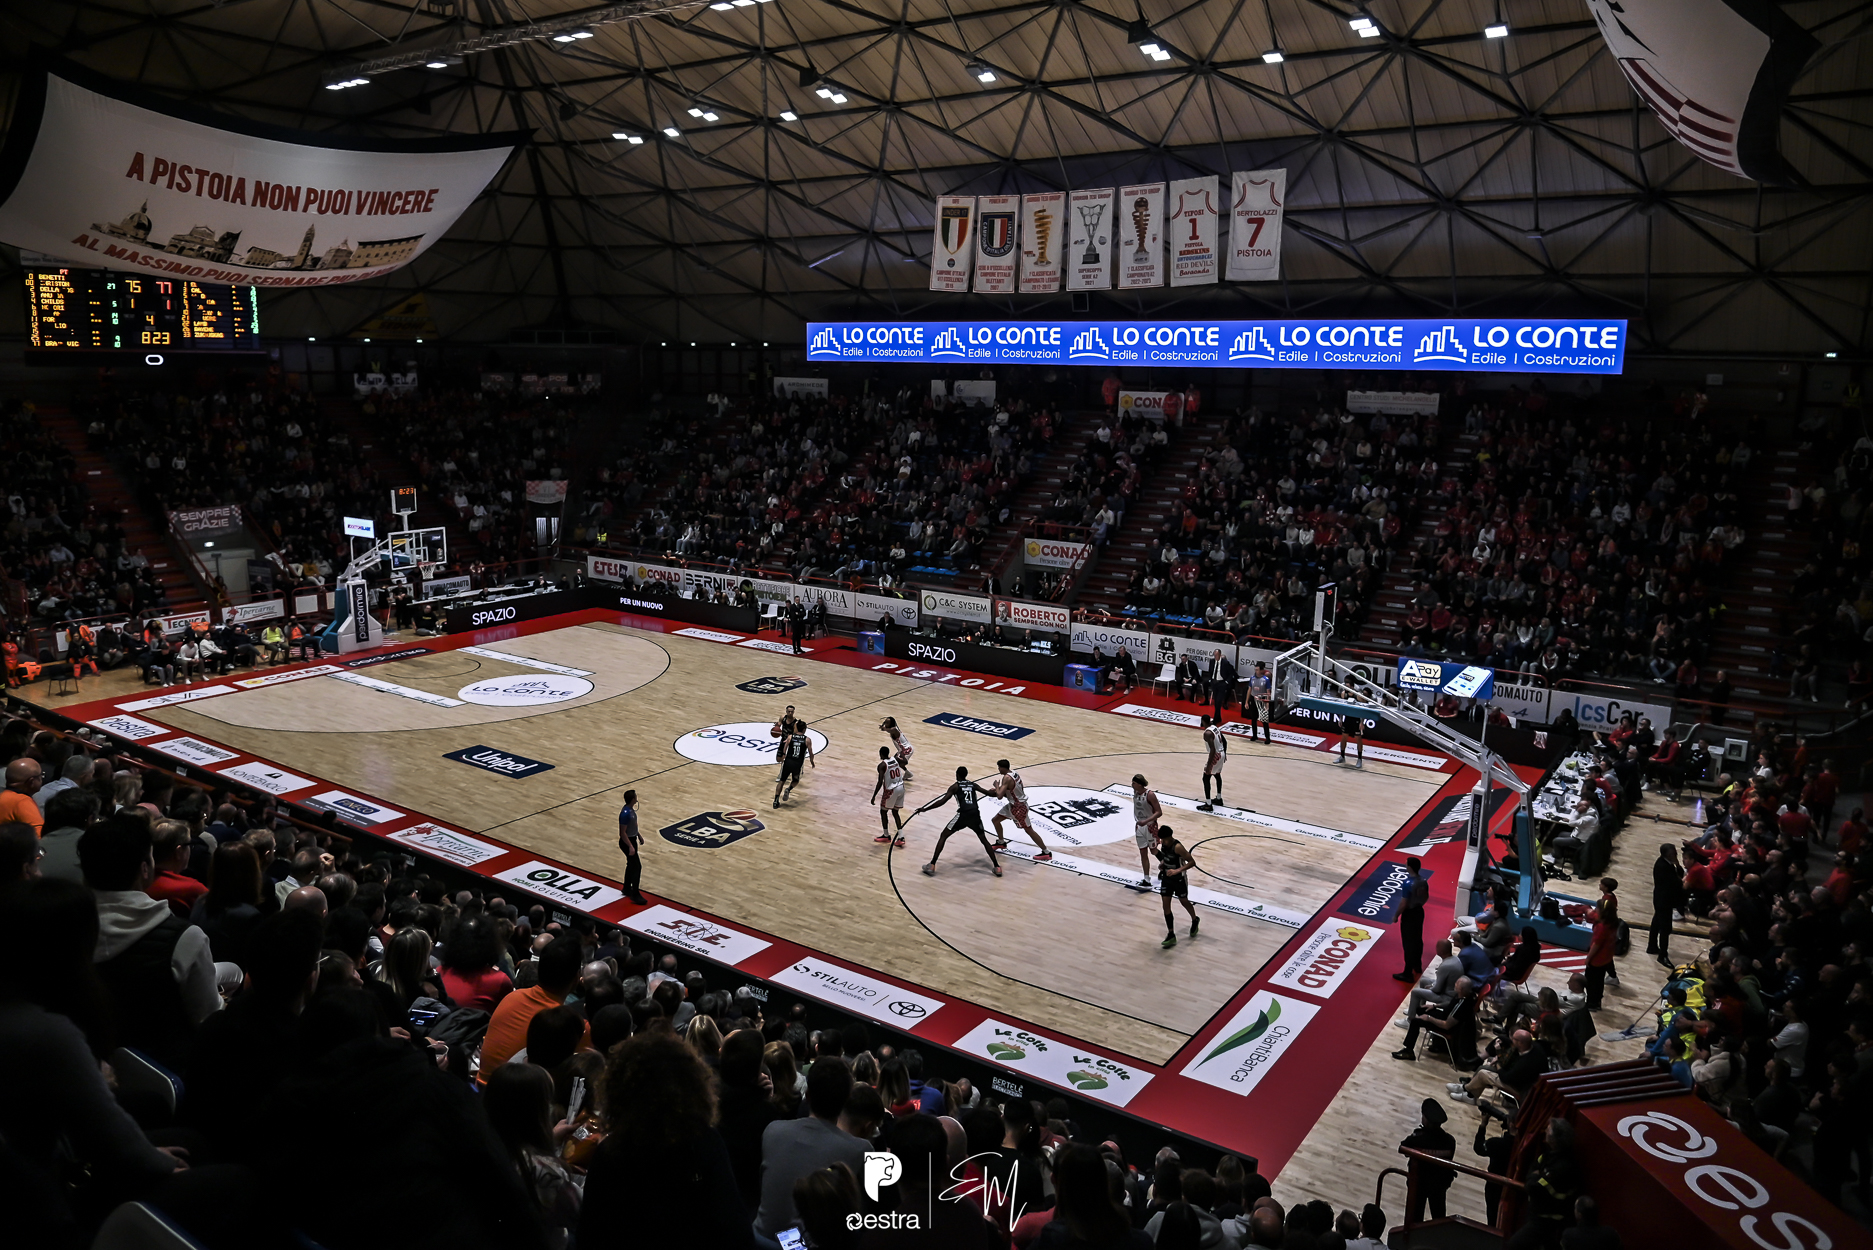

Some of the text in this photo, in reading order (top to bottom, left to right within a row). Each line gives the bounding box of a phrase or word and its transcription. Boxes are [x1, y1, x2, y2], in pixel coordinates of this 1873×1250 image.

[126, 152, 439, 216] A PISTOIA NON PUOI VINCERE
[1184, 209, 1204, 217] TIFOSI
[1237, 209, 1278, 217] BERTOLAZZI
[1189, 218, 1200, 241] 1
[1247, 217, 1266, 248] 7
[1179, 248, 1210, 256] REDSKINS
[1237, 249, 1272, 258] PISTOIA
[72, 234, 329, 286] AL MASSIMO PUOI SEGNARE
[1191, 260, 1214, 268] DEVILS
[1180, 268, 1210, 277] Baraonda
[125, 280, 142, 293] 75
[155, 281, 173, 294] 77
[131, 298, 135, 309] 1
[166, 299, 171, 310] 1
[146, 315, 155, 326] 4
[843, 328, 924, 344] LO CONTE
[968, 328, 1061, 345] LO CONTE
[1112, 328, 1219, 346] LO CONTE
[1280, 326, 1403, 347] LO CONTE
[1474, 326, 1618, 349] LO CONTE
[842, 348, 924, 357] Edile Costruzioni
[968, 349, 1061, 359] Edile Costruzioni
[1112, 350, 1219, 361] Edile Costruzioni
[1278, 352, 1402, 363] Edile Costruzioni
[1472, 353, 1615, 367] Edile Costruzioni
[180, 508, 231, 522] SEMPRE
[184, 518, 230, 532] GRAZIE
[1041, 545, 1089, 560] CONAD
[594, 561, 618, 576] ETES
[647, 570, 681, 583] CONAD
[686, 573, 726, 589] BERNI
[620, 597, 632, 605] PER
[642, 601, 664, 611] NUOVO
[802, 588, 849, 608] AURORA
[939, 598, 988, 613] C&C SYSTEM
[865, 602, 895, 612] STILAUTO
[472, 606, 516, 626] SPAZIO
[1013, 607, 1067, 623] ROBERTO
[1014, 618, 1039, 627] SEMPRE
[1094, 632, 1147, 648] LO CONTE
[908, 642, 956, 663] SPAZIO
[1156, 651, 1174, 664] B.G
[872, 663, 1027, 695] PISTOIA
[1401, 676, 1439, 685] E-WALLET
[502, 688, 574, 698] CONTE
[1289, 708, 1331, 721] PER UN
[1574, 696, 1644, 726] IcsCar
[110, 718, 156, 738] estra
[950, 717, 1019, 735] Unipol
[472, 750, 539, 774] Unipol
[890, 768, 901, 780] 00
[964, 791, 973, 801] 21
[342, 800, 374, 814] FINECO
[1472, 803, 1481, 838] perdormire
[674, 833, 697, 843] SERIE
[676, 822, 733, 844] LBA
[1052, 828, 1082, 846] FINESTRA
[1350, 838, 1378, 850] Group
[1001, 848, 1077, 870] Giorgio Group
[528, 869, 602, 900] OLLA
[1099, 872, 1133, 885] Giorgio
[1358, 864, 1410, 916] perdormire
[1208, 899, 1301, 928] Giorgio Tesi Group
[644, 928, 711, 956] ENGINEERING SRL
[1282, 932, 1332, 979] Persone oltre le cose
[1298, 939, 1358, 989] CONAD
[811, 970, 878, 997] STILAUTO
[994, 1029, 1012, 1037] Le
[1073, 1056, 1092, 1064] Le
[1230, 1025, 1291, 1083] ChiantiBanca
